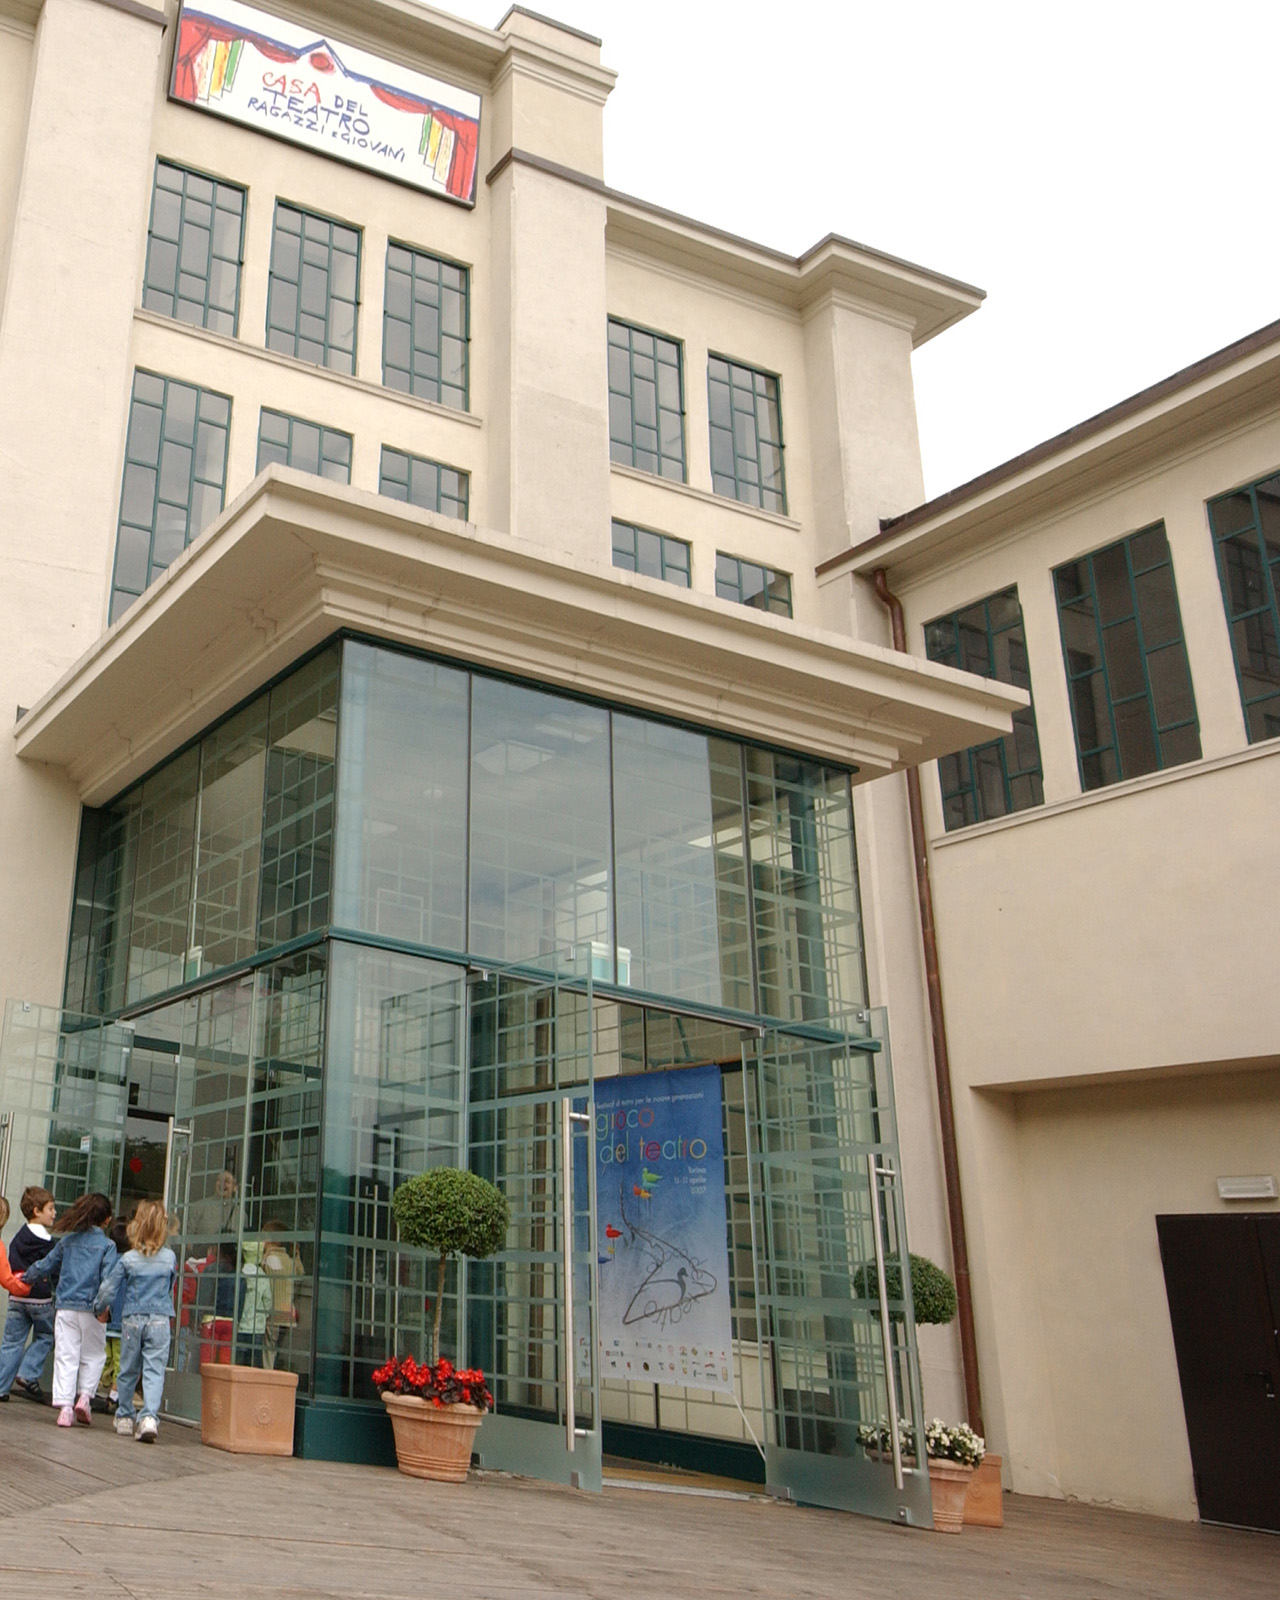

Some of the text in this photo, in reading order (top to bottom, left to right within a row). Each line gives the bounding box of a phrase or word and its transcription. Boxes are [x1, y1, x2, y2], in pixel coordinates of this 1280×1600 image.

[262, 71, 368, 117] CASA DEL
[262, 86, 370, 135] TEATRO
[247, 97, 325, 135] RAGAZZI
[340, 132, 406, 163] GIOVANI
[596, 1107, 654, 1141] gioco
[600, 1131, 707, 1164] del teatro
